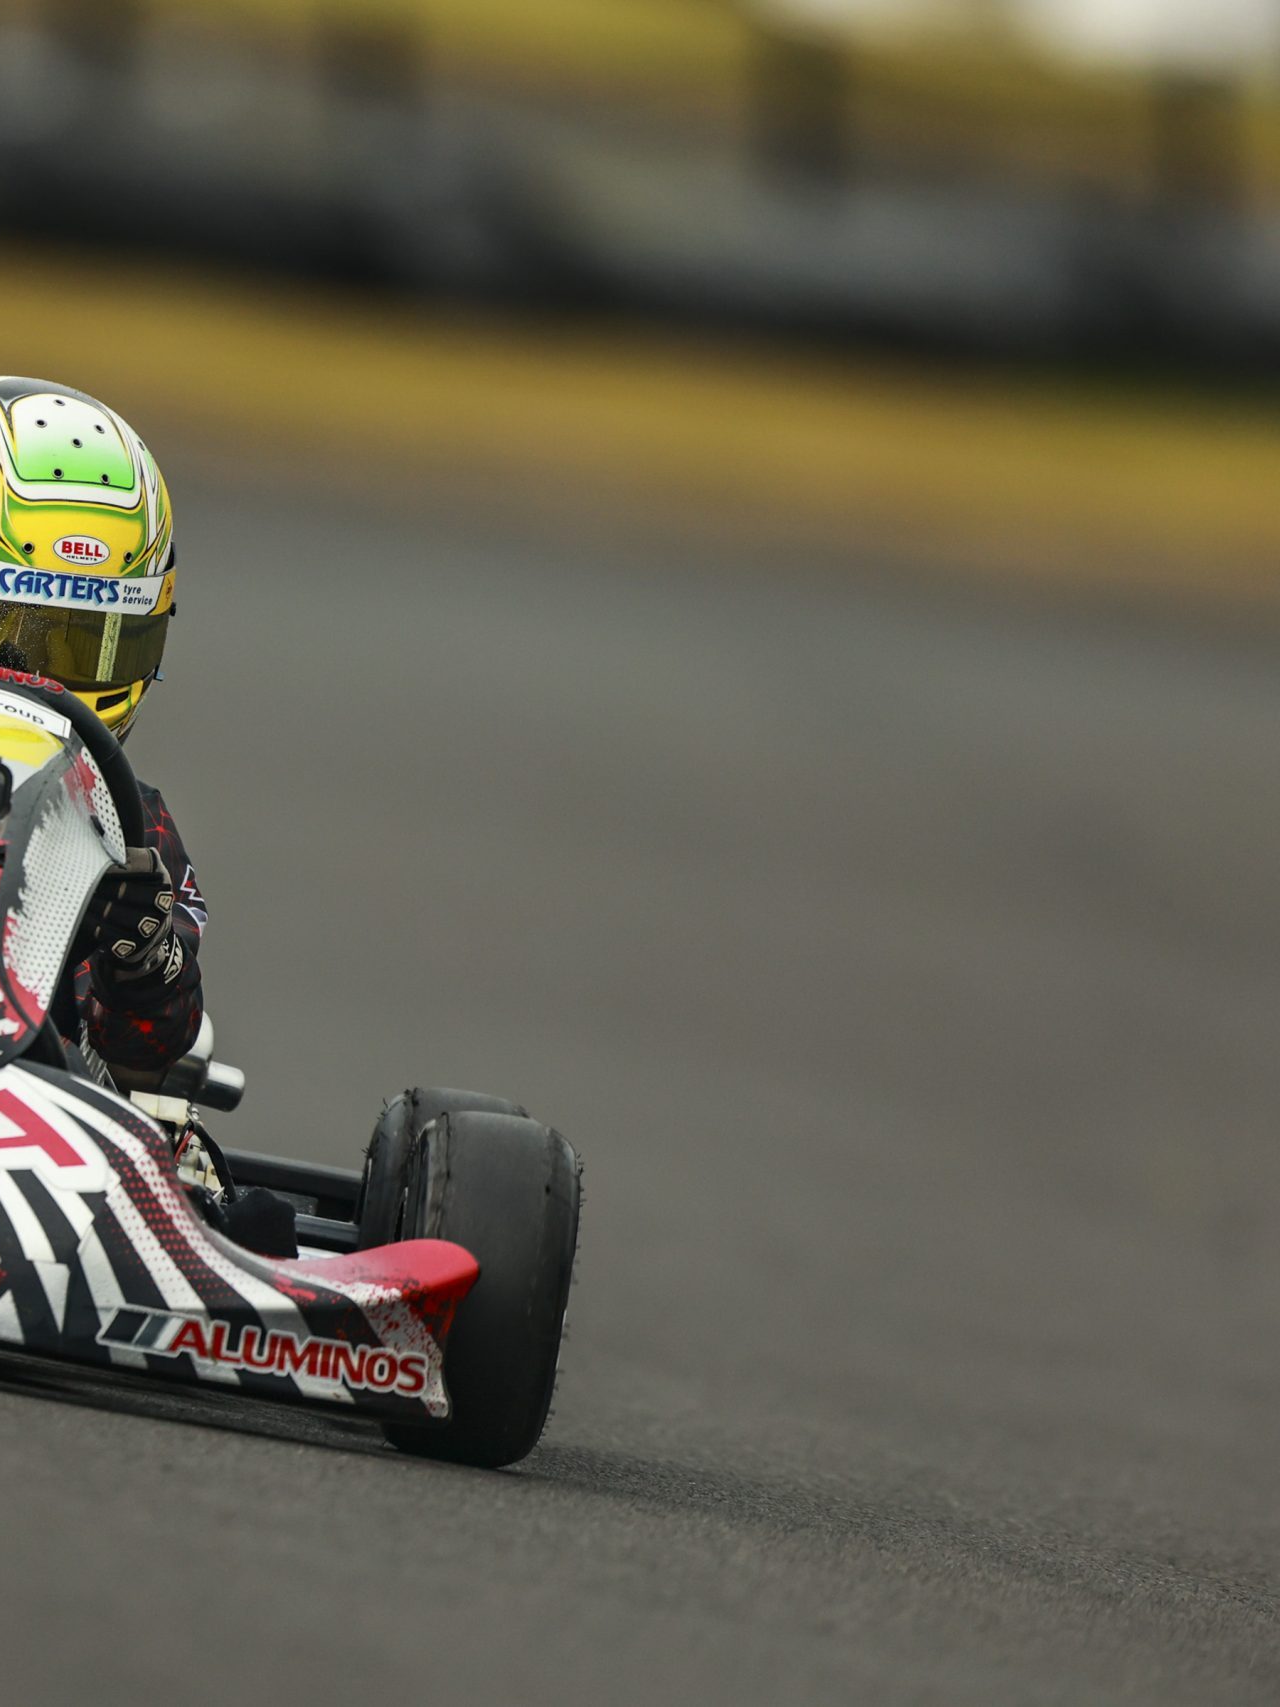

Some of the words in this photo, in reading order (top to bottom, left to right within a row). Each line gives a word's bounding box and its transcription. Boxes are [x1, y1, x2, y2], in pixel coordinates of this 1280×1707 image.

[61, 540, 103, 558] BELL
[123, 584, 142, 595] tyre
[122, 595, 153, 606] service
[170, 1319, 426, 1393] ALUMINOS
